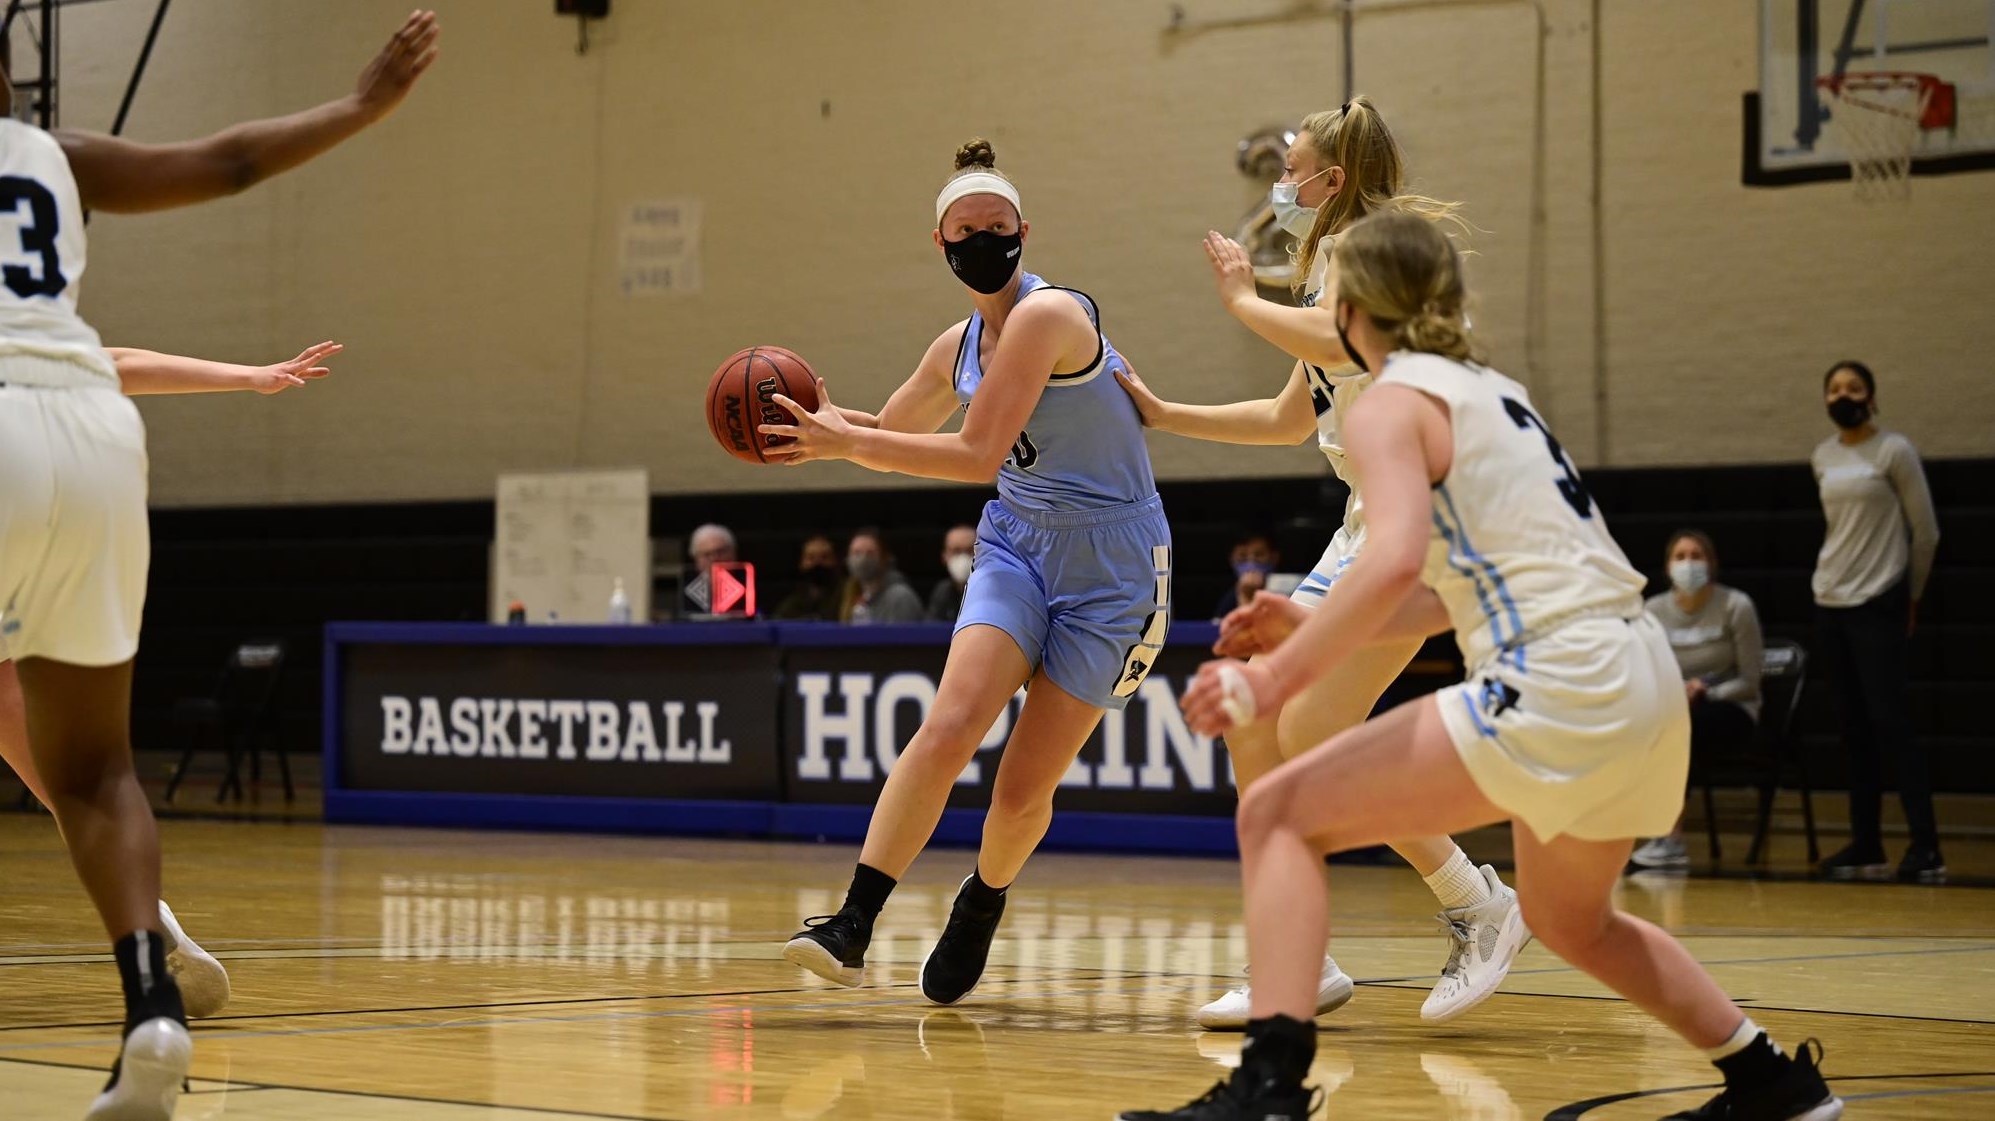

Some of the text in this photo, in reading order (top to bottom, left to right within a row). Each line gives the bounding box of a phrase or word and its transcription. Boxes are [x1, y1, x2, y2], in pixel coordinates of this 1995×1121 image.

[0, 175, 67, 298] 3
[725, 394, 750, 453] NCAA
[756, 376, 785, 447] Wilo
[1004, 430, 1038, 469] 0
[381, 673, 1236, 790] BASKETBALL HOIN
